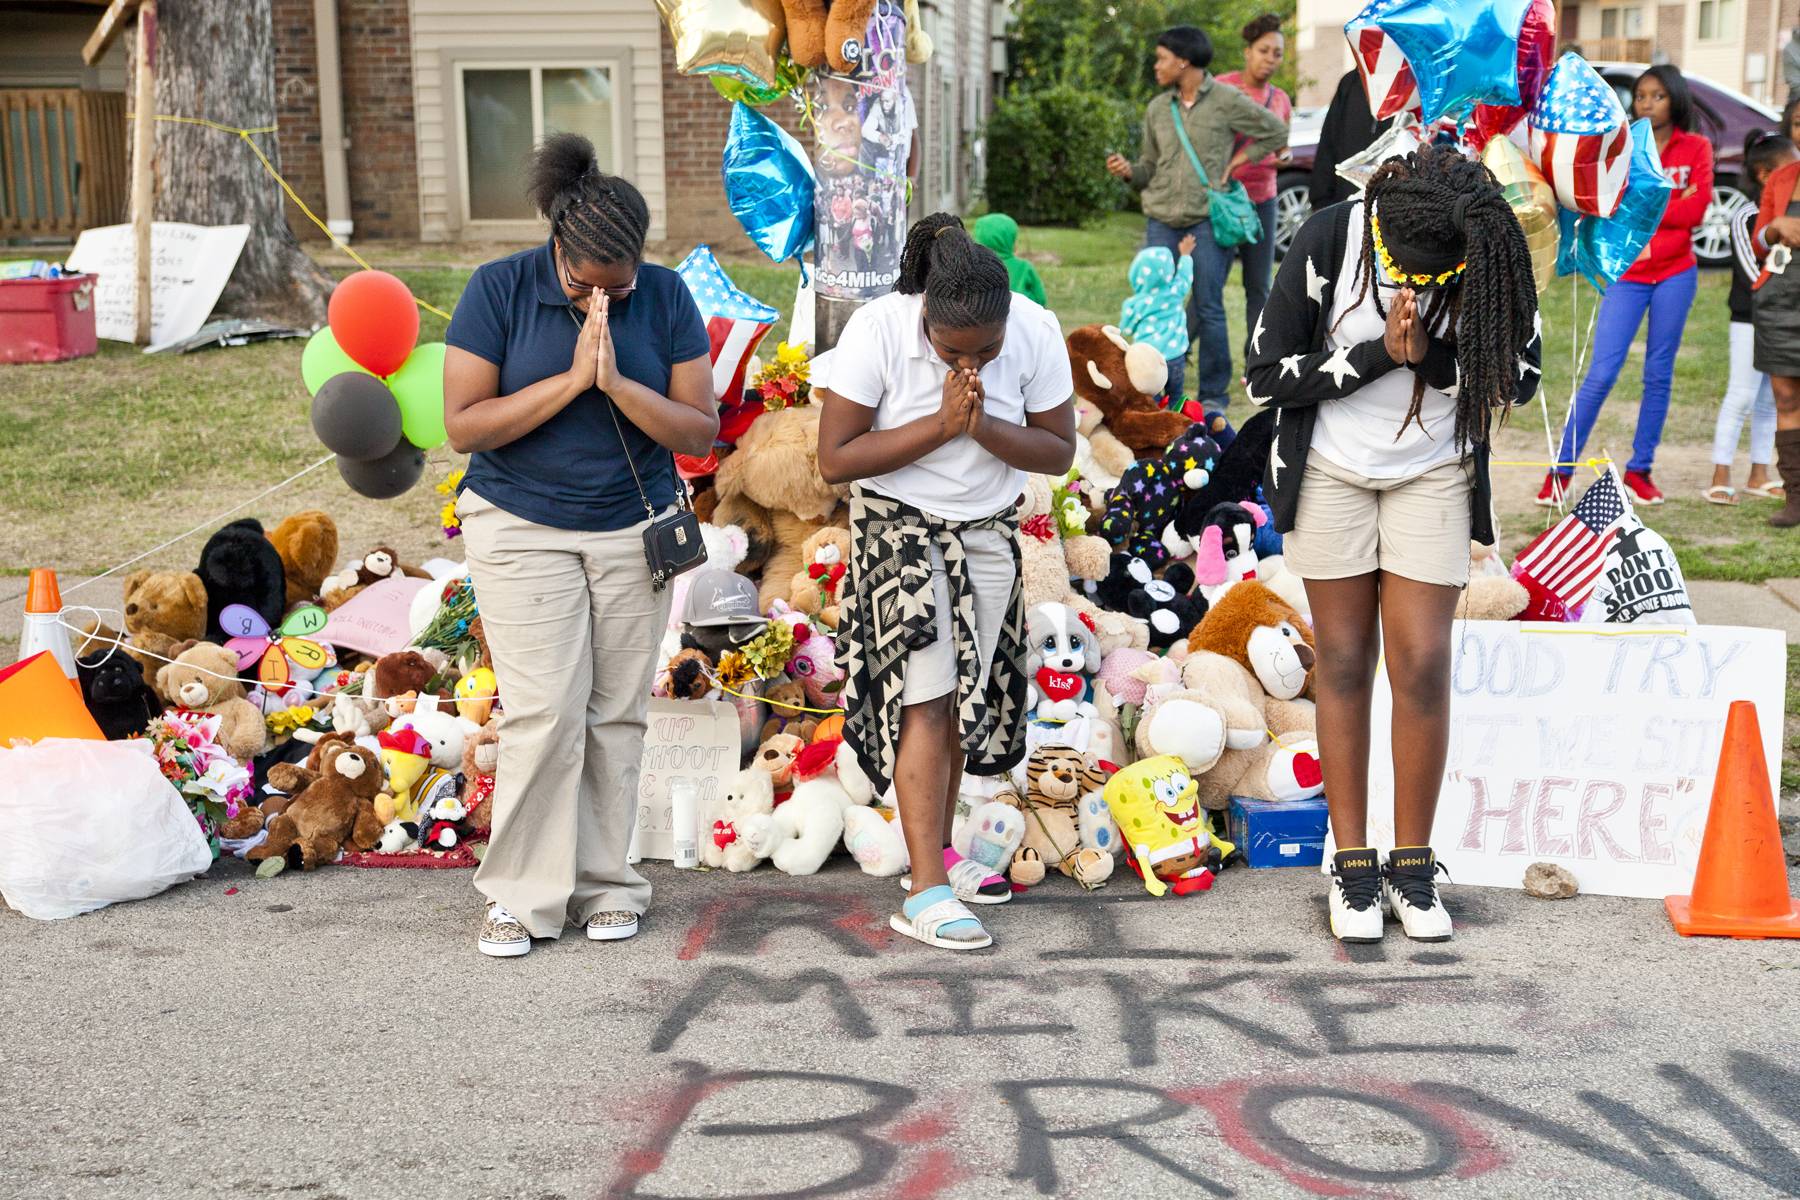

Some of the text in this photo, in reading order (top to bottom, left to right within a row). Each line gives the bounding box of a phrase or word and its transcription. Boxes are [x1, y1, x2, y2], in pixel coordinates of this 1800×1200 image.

[1606, 549, 1667, 586] DON'T
[1604, 566, 1678, 614] SHOO
[1633, 597, 1661, 614] MIKE
[1049, 675, 1074, 690] kiss
[1451, 633, 1751, 699] OOD TRY
[653, 717, 695, 742] UP
[1536, 713, 1618, 769] WE
[664, 775, 719, 801] FR
[649, 963, 1518, 1068] MIKE
[600, 1050, 1800, 1200] BROW
